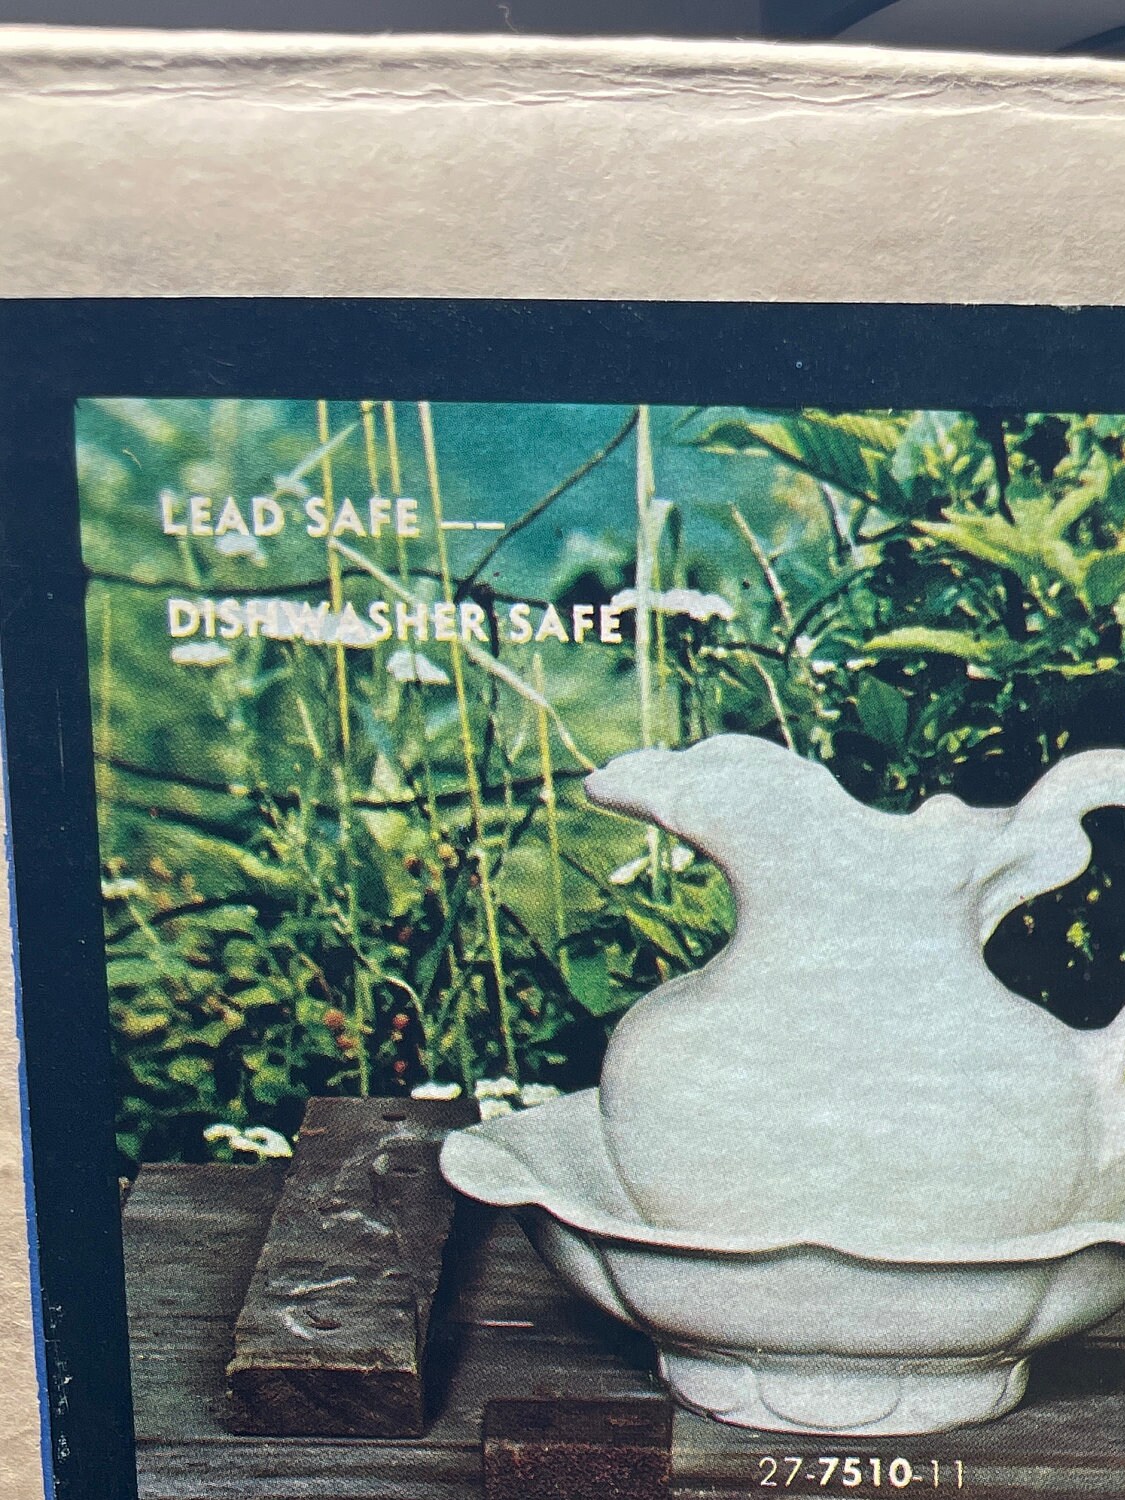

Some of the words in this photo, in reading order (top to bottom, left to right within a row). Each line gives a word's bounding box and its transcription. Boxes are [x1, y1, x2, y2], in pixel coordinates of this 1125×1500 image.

[160, 490, 285, 538] LEAD
[307, 496, 420, 538] SAFE
[168, 598, 490, 644] DISHWASHER
[509, 603, 624, 644] SAFE
[758, 1456, 965, 1489] 27-7510-11
